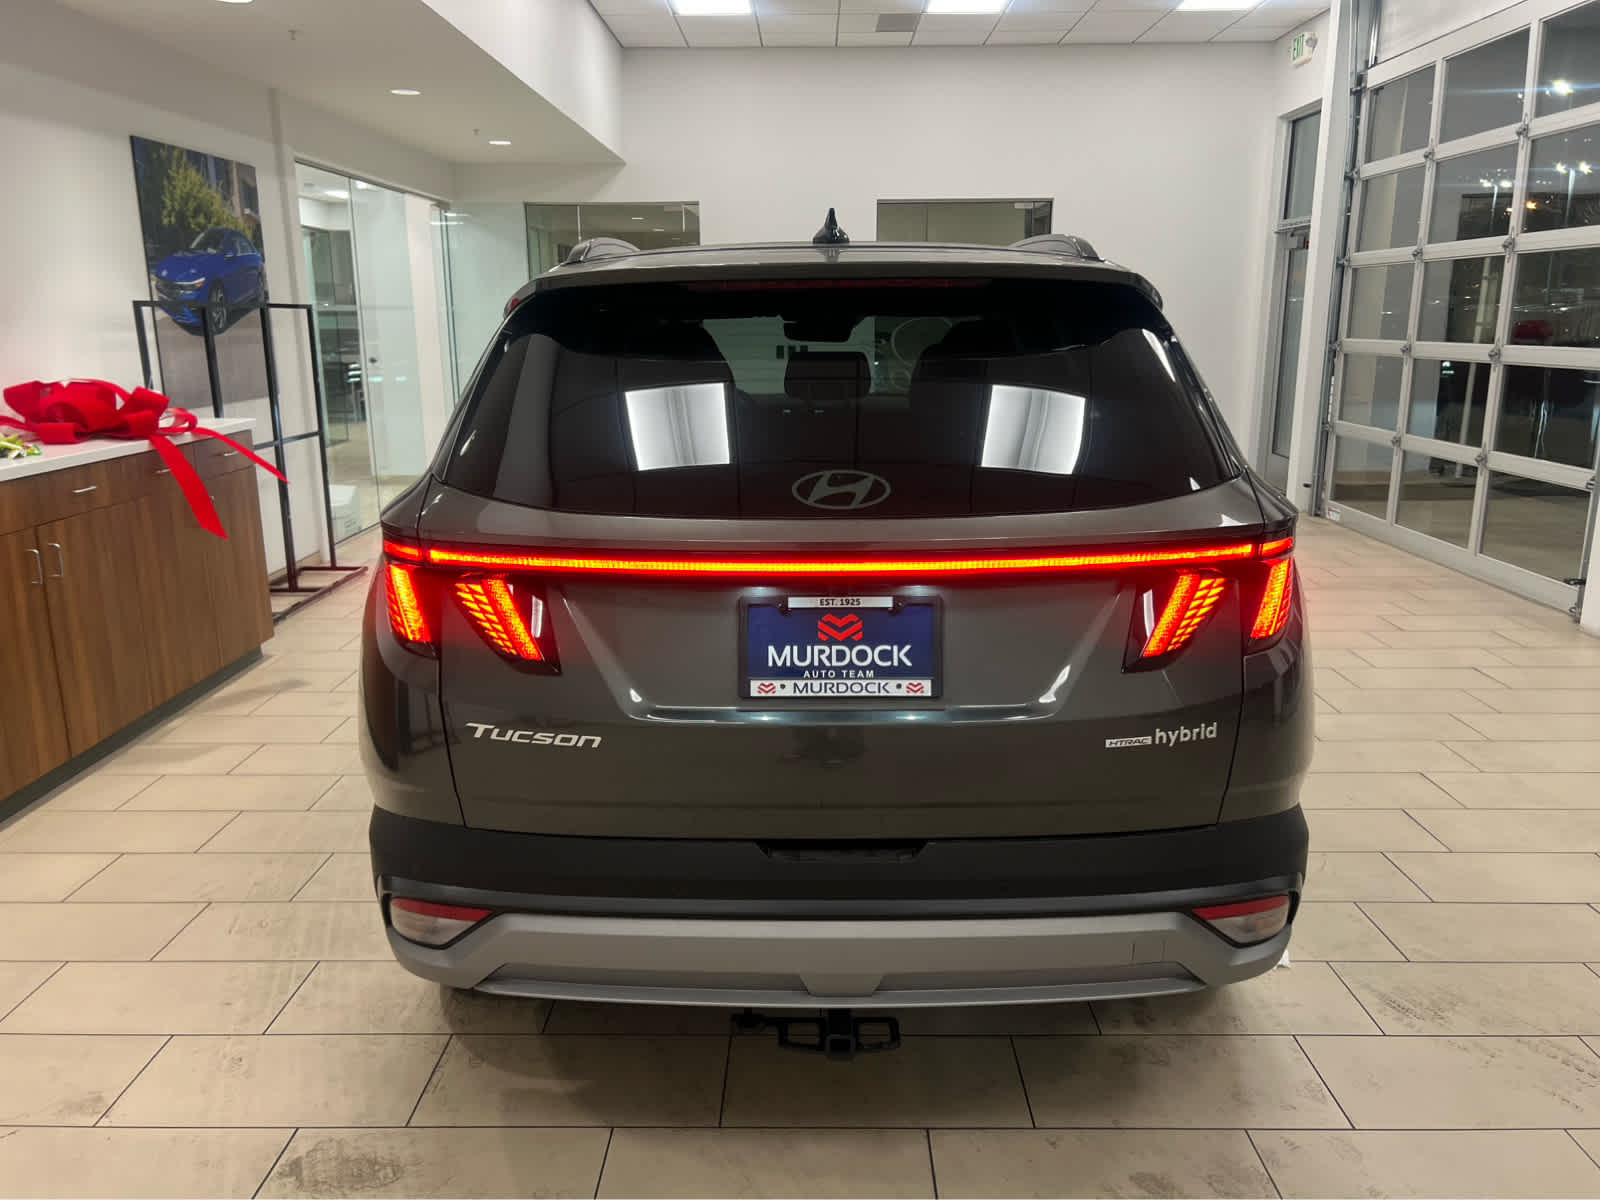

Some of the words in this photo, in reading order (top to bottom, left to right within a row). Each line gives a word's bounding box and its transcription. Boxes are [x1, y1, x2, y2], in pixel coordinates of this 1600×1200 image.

[1292, 34, 1305, 61] EXIT
[819, 598, 837, 607] EST.
[839, 598, 861, 607] 1925
[767, 644, 912, 667] MURDOCK
[803, 670, 836, 679] AUTO
[841, 670, 874, 679] TEAM
[792, 681, 890, 694] MURDOCK
[1154, 721, 1217, 747] hybrid
